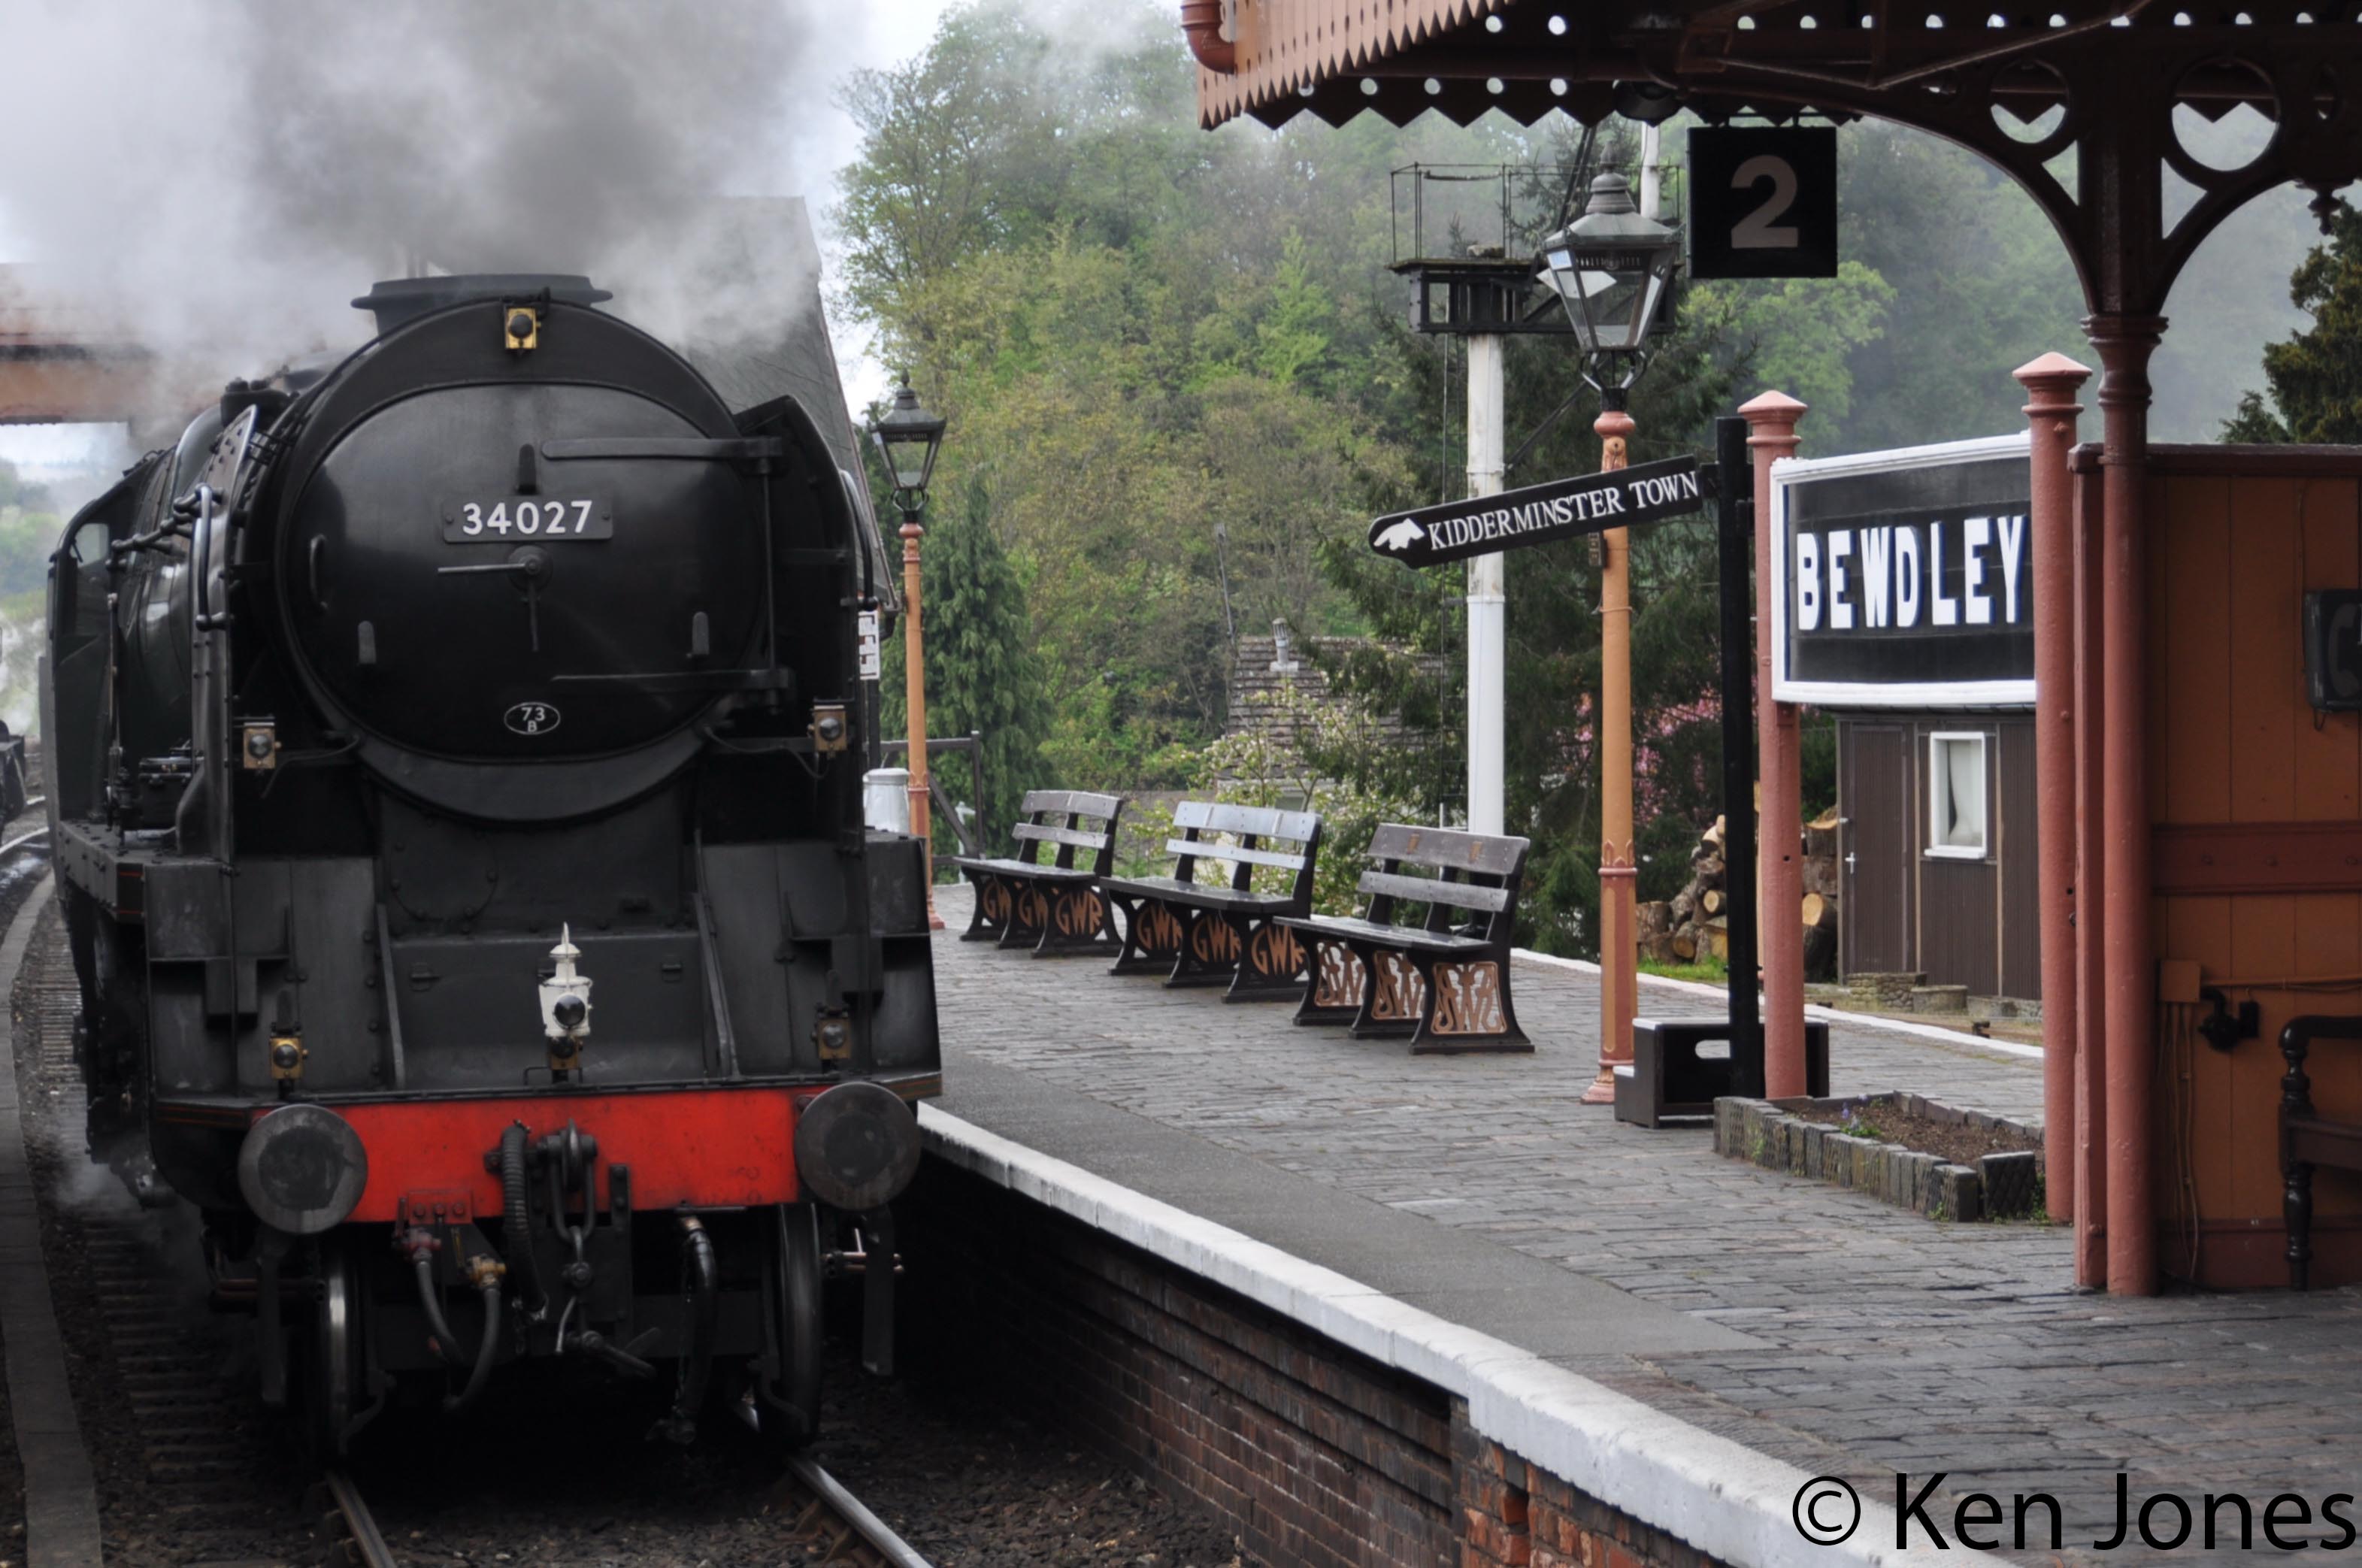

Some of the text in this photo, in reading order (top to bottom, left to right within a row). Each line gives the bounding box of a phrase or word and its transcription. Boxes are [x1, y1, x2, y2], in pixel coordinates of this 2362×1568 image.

[1731, 154, 1799, 249] 2
[462, 500, 593, 535] 34027
[1427, 471, 1699, 551] KIDDERMINSTER TOWN
[1797, 515, 2027, 630] BEWDLEY
[521, 707, 547, 722] 73
[527, 721, 538, 733] B
[983, 882, 1012, 922] GW
[1019, 888, 1049, 928] GW
[1055, 890, 1104, 936] GWR
